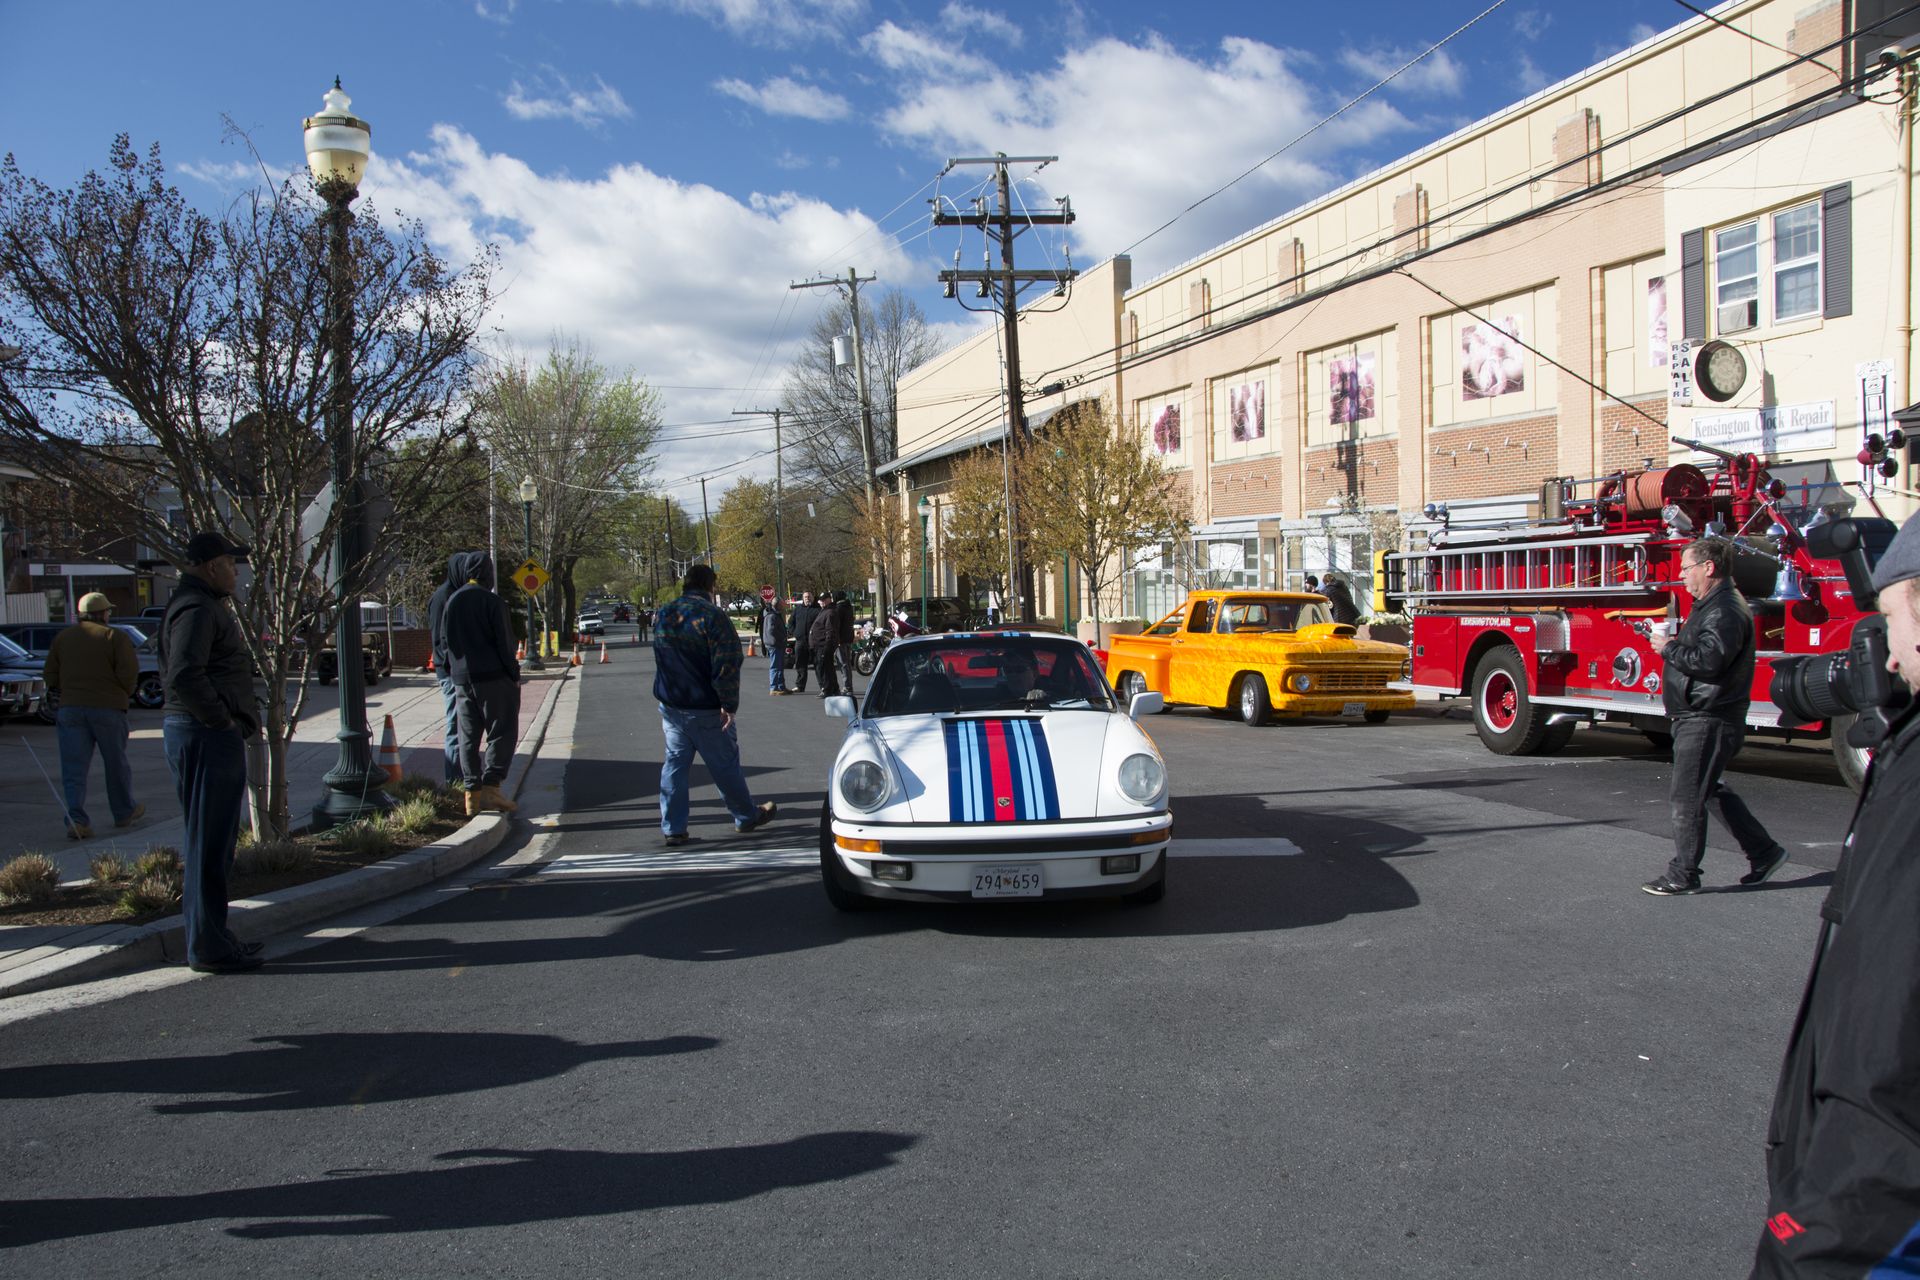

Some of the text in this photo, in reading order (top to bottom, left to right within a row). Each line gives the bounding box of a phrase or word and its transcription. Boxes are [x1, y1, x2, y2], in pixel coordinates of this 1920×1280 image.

[1671, 344, 1680, 398] REPAIR
[1680, 342, 1691, 398] SALE
[1694, 406, 1830, 440] Kensington Clock Repair
